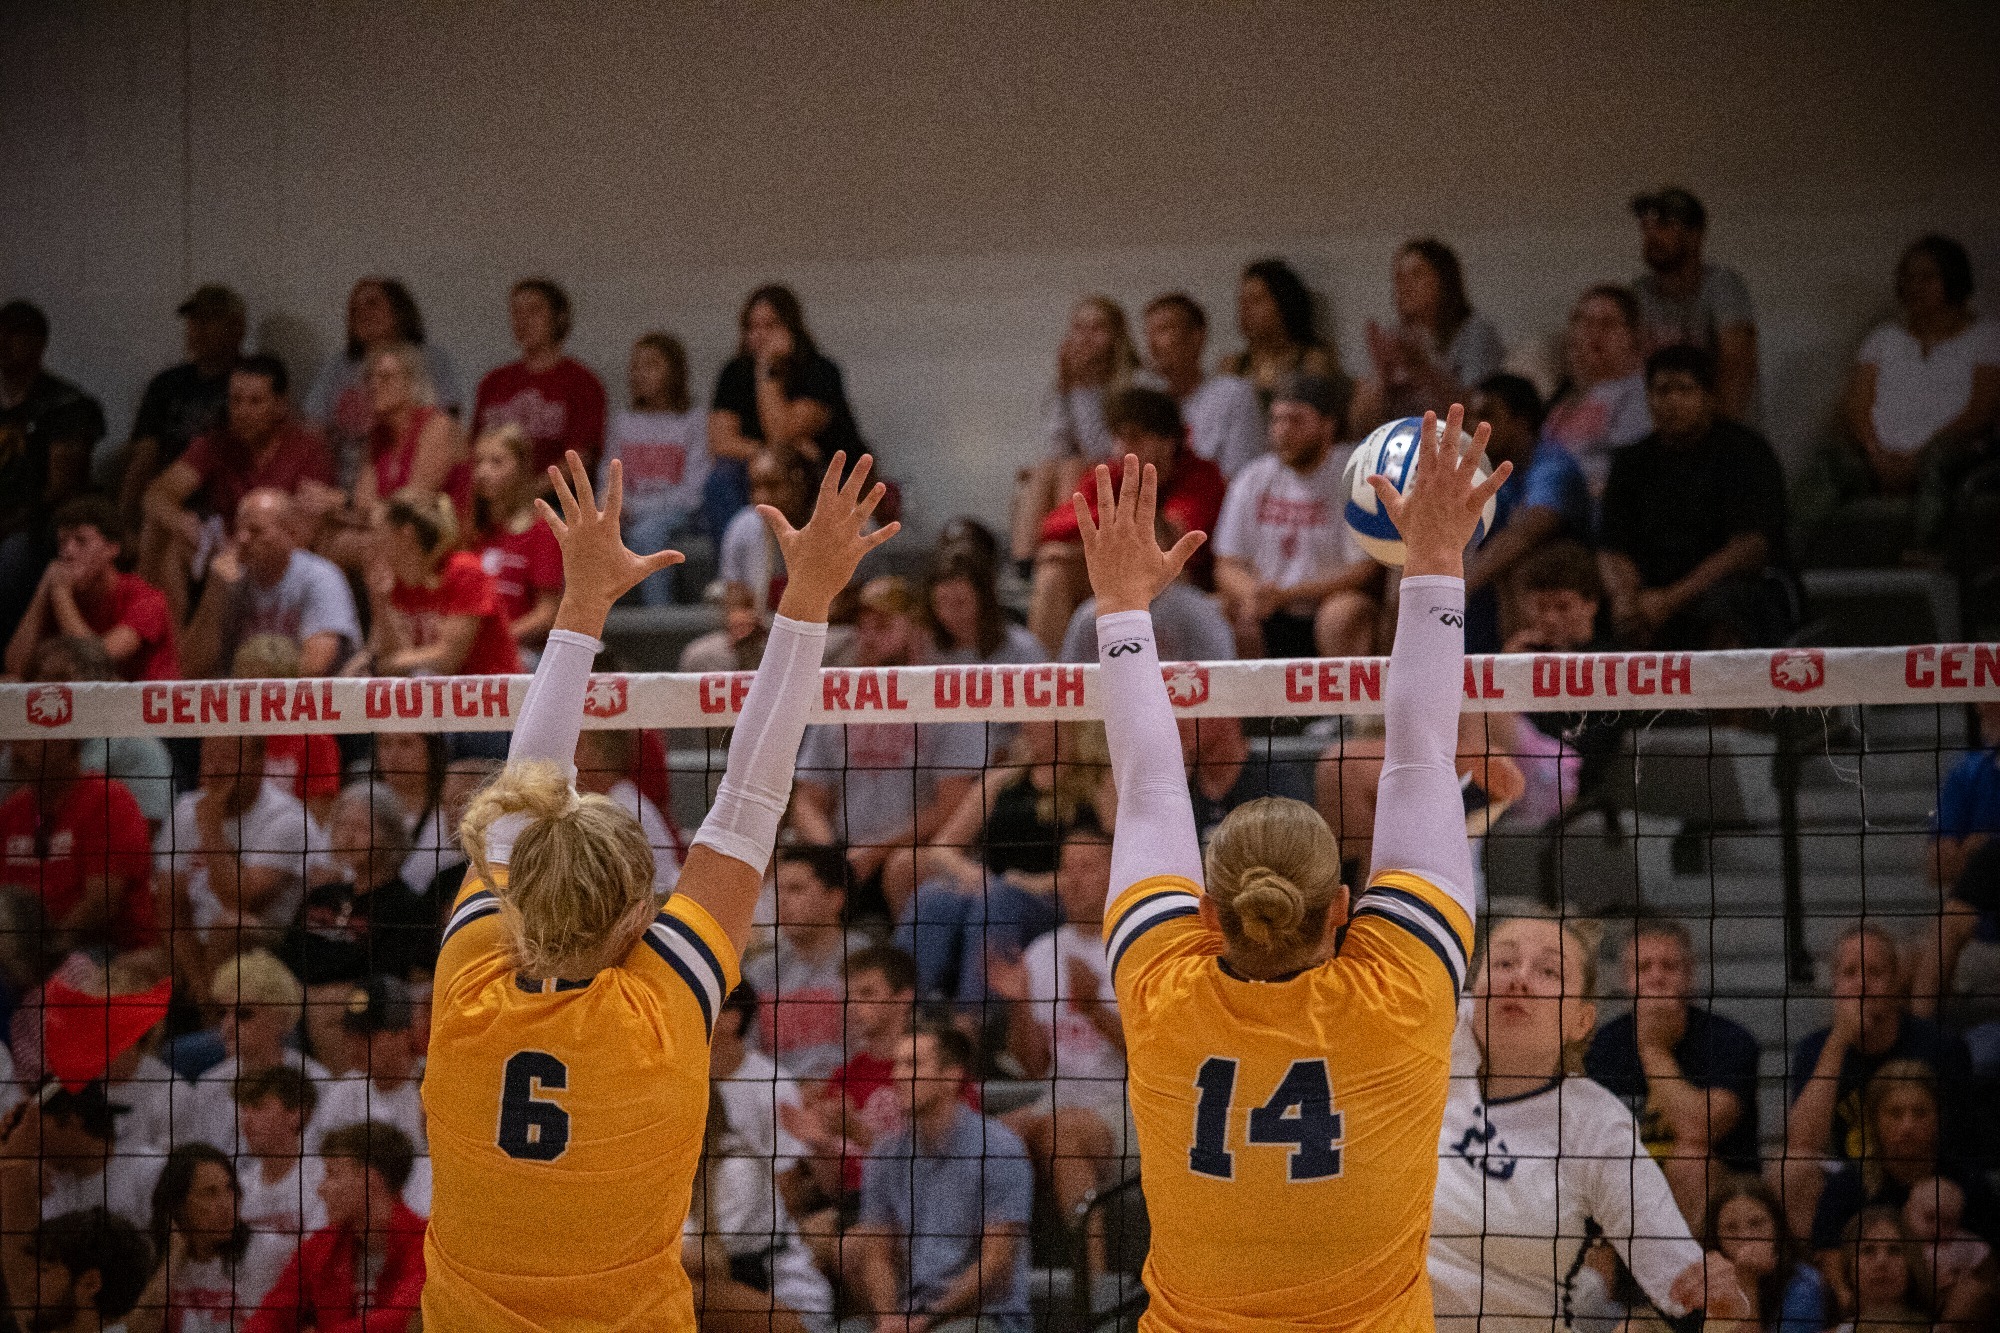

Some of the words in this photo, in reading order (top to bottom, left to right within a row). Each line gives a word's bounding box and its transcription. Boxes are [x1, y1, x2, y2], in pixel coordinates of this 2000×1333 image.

[142, 680, 342, 724] CENTRAL
[365, 678, 510, 719] DUTCH
[700, 669, 909, 715] CERAL
[934, 667, 1084, 709] DUTCH
[1285, 656, 1505, 703] CENAL
[1532, 654, 1692, 698] DUTCH
[496, 1050, 570, 1163] 6
[1187, 1055, 1344, 1184] 14
